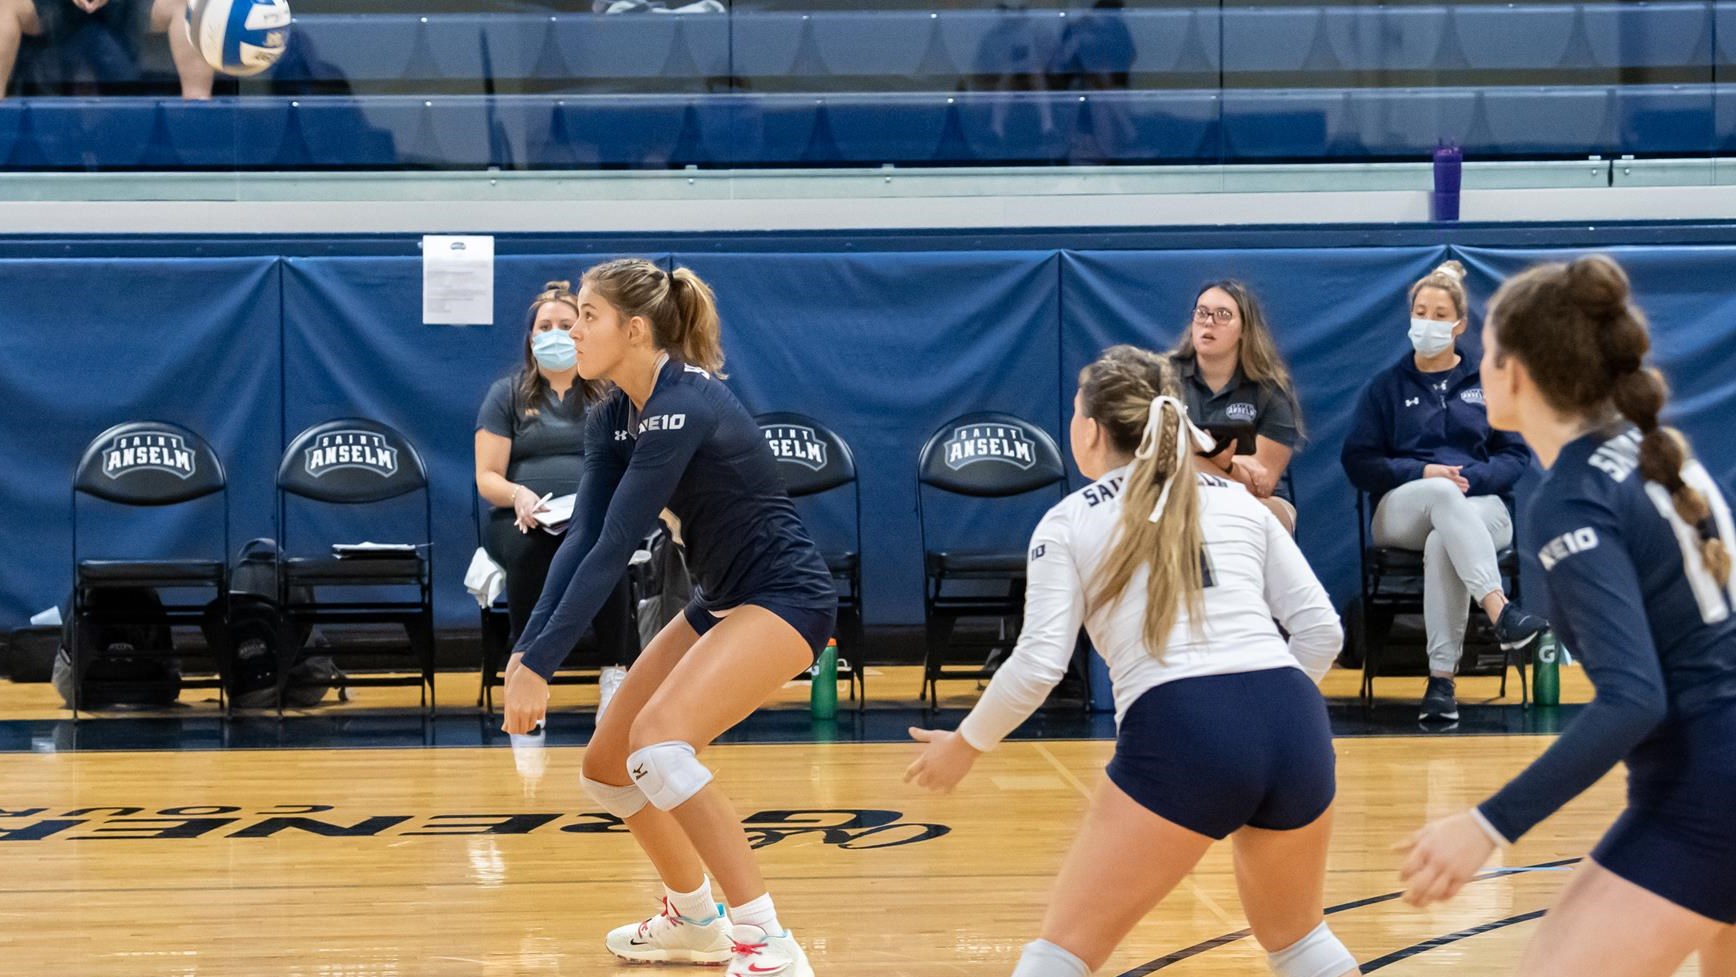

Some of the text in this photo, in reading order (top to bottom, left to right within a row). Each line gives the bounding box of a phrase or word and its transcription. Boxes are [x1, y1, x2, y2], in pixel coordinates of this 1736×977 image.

[120, 436, 178, 449] SAINT
[323, 434, 380, 448] SAINT
[764, 428, 808, 440] AINT
[961, 427, 1017, 440] SAINT
[108, 447, 191, 472] ANSELM
[310, 445, 393, 470] ANSELM
[768, 439, 822, 463] SELM
[949, 438, 1031, 463] ANSELM
[1539, 644, 1555, 664] G
